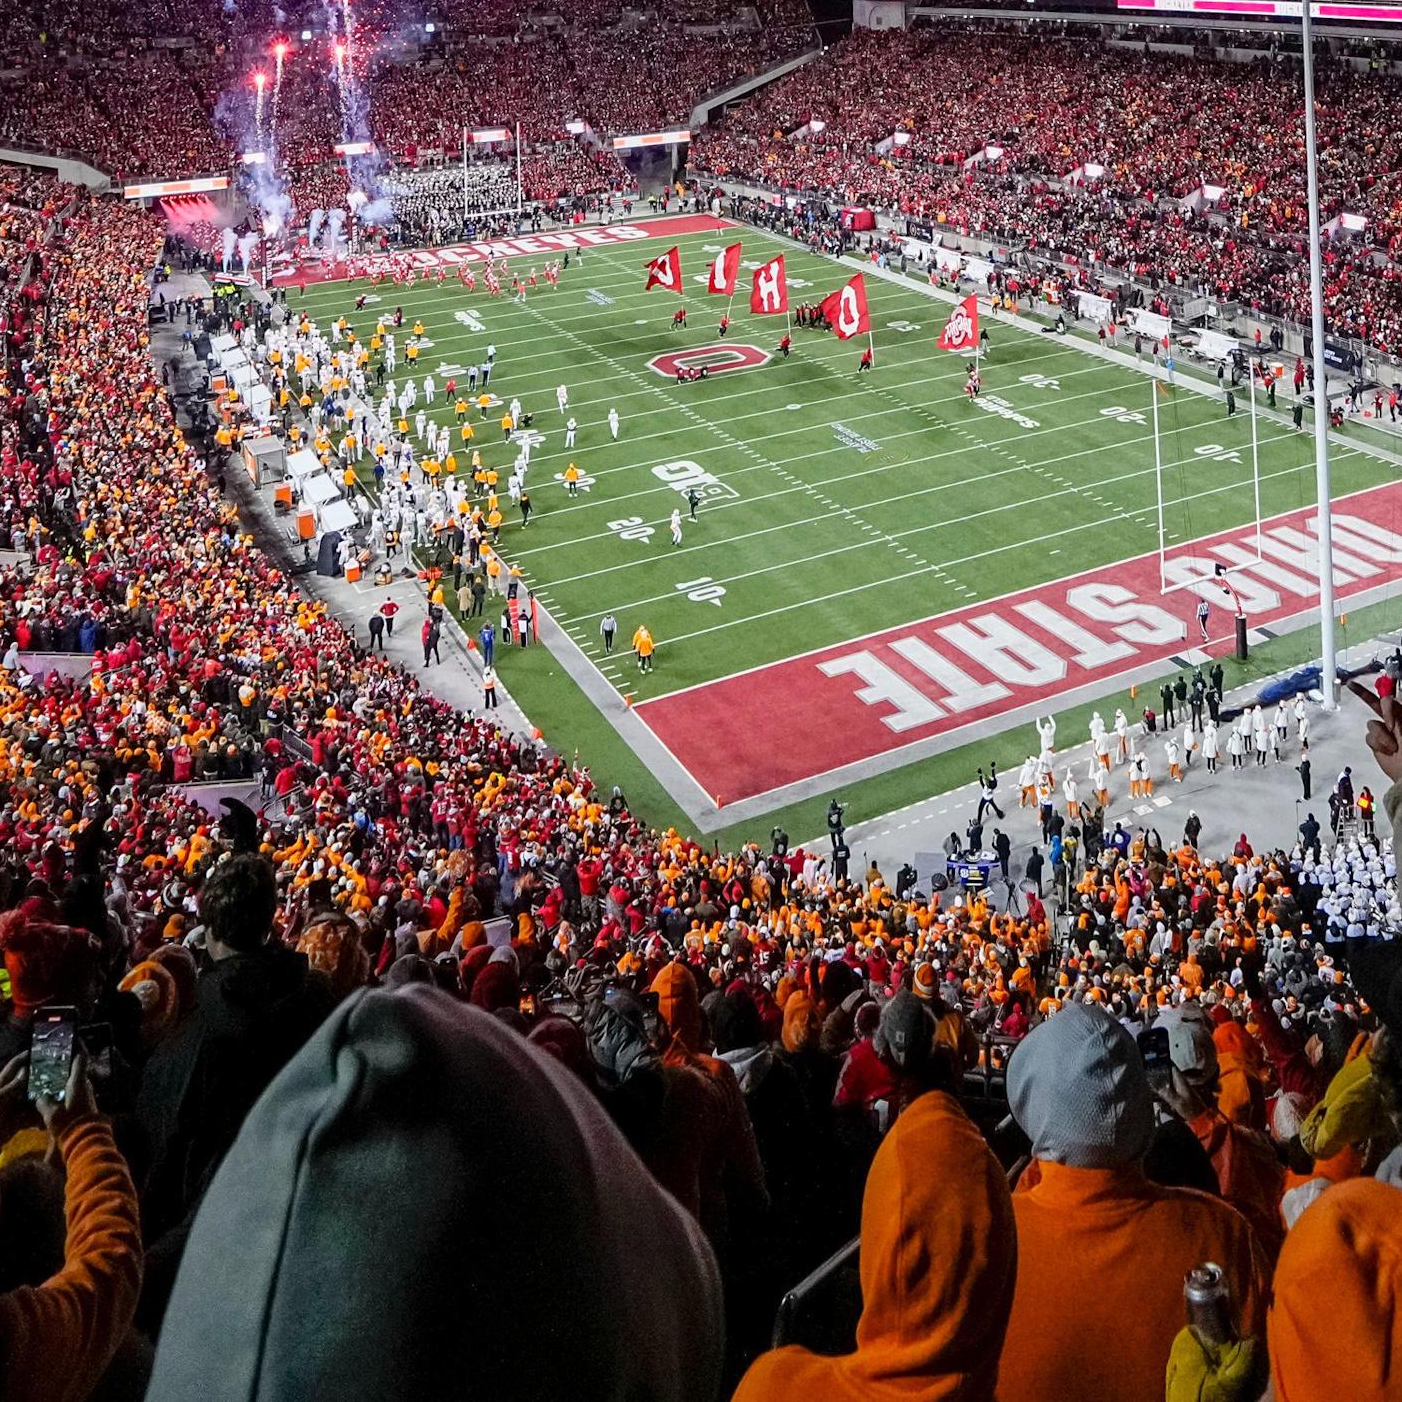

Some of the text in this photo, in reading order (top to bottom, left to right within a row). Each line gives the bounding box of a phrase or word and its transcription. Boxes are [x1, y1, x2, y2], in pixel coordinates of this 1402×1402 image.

[758, 260, 782, 313] H
[607, 516, 655, 541] 20
[674, 576, 727, 602] 10
[815, 582, 1188, 734] STATE
[759, 949, 771, 966] 15
